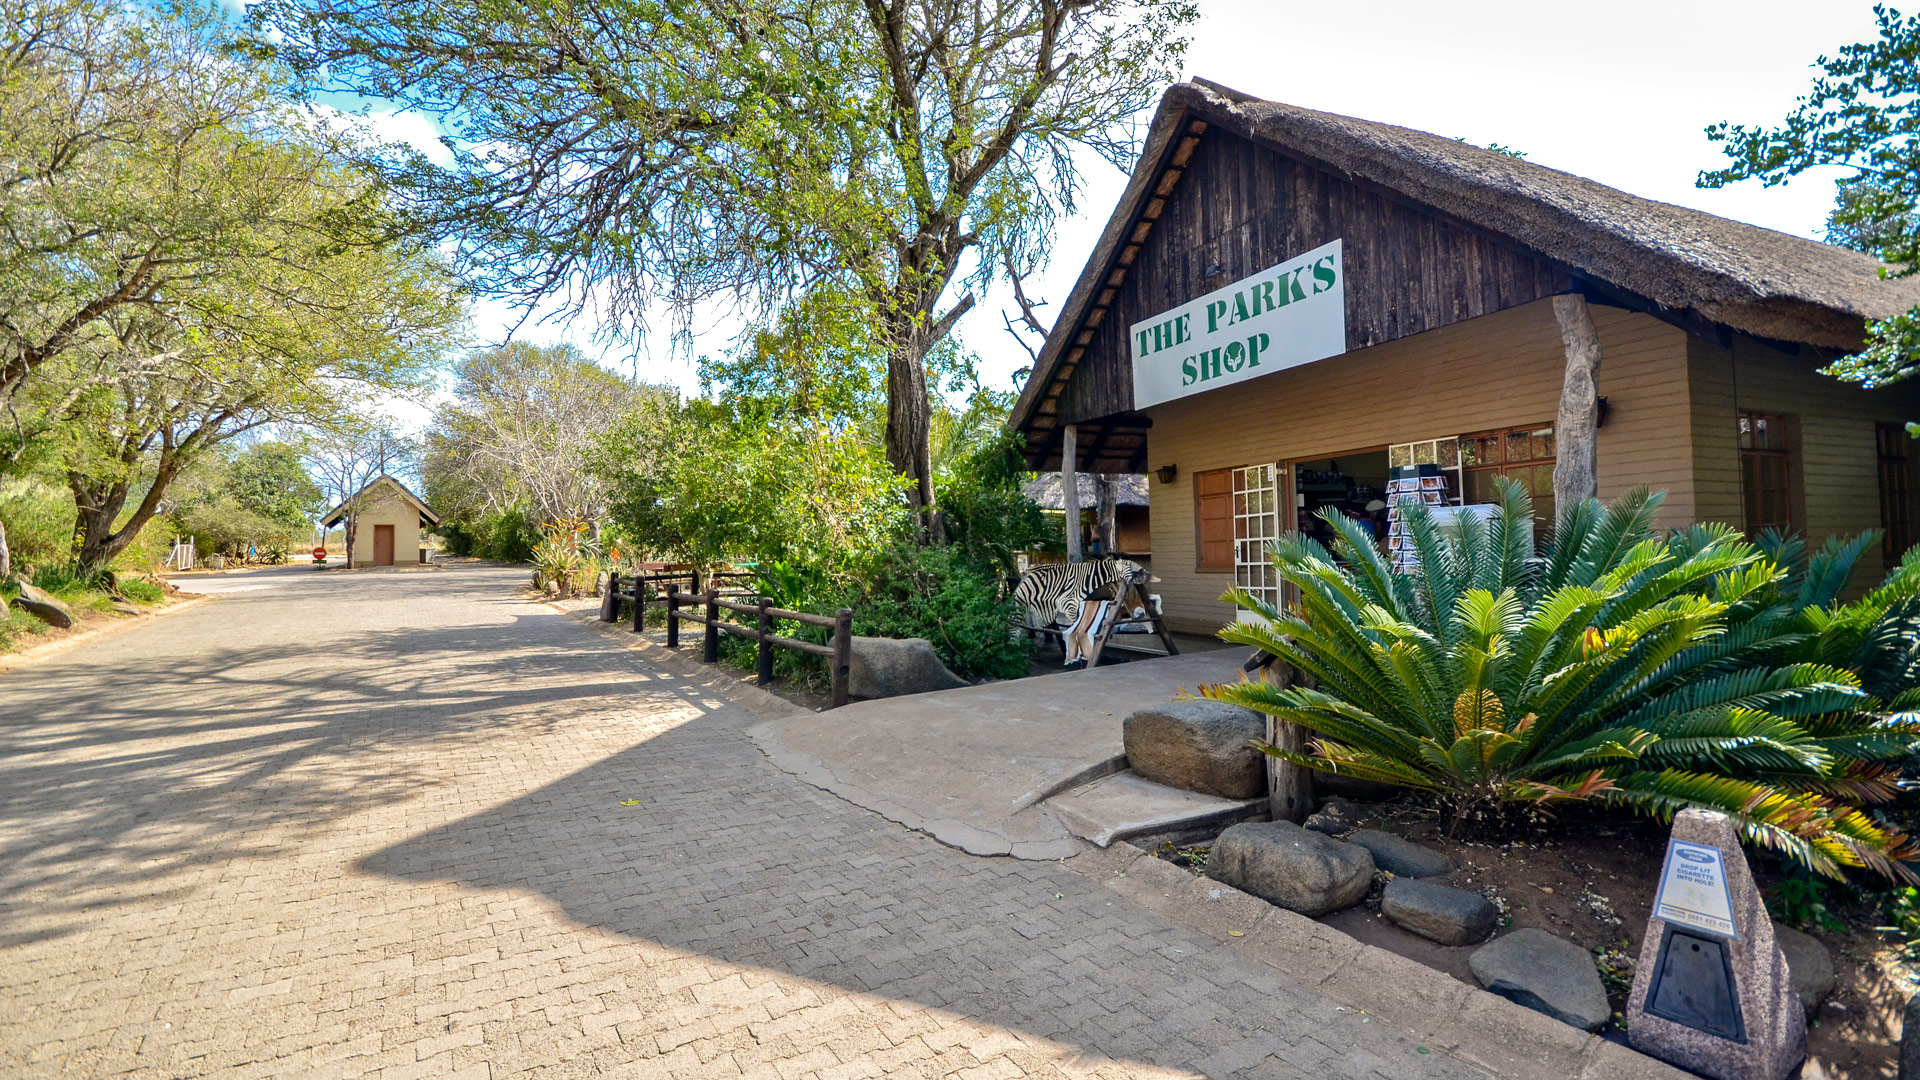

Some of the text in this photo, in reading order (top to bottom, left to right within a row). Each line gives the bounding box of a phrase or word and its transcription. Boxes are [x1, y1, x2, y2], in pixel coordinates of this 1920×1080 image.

[1135, 254, 1336, 358] THE PARK'S
[1182, 332, 1270, 387] SHOP
[1677, 868, 1714, 880] CIGARETTE
[1680, 863, 1698, 871] DROP
